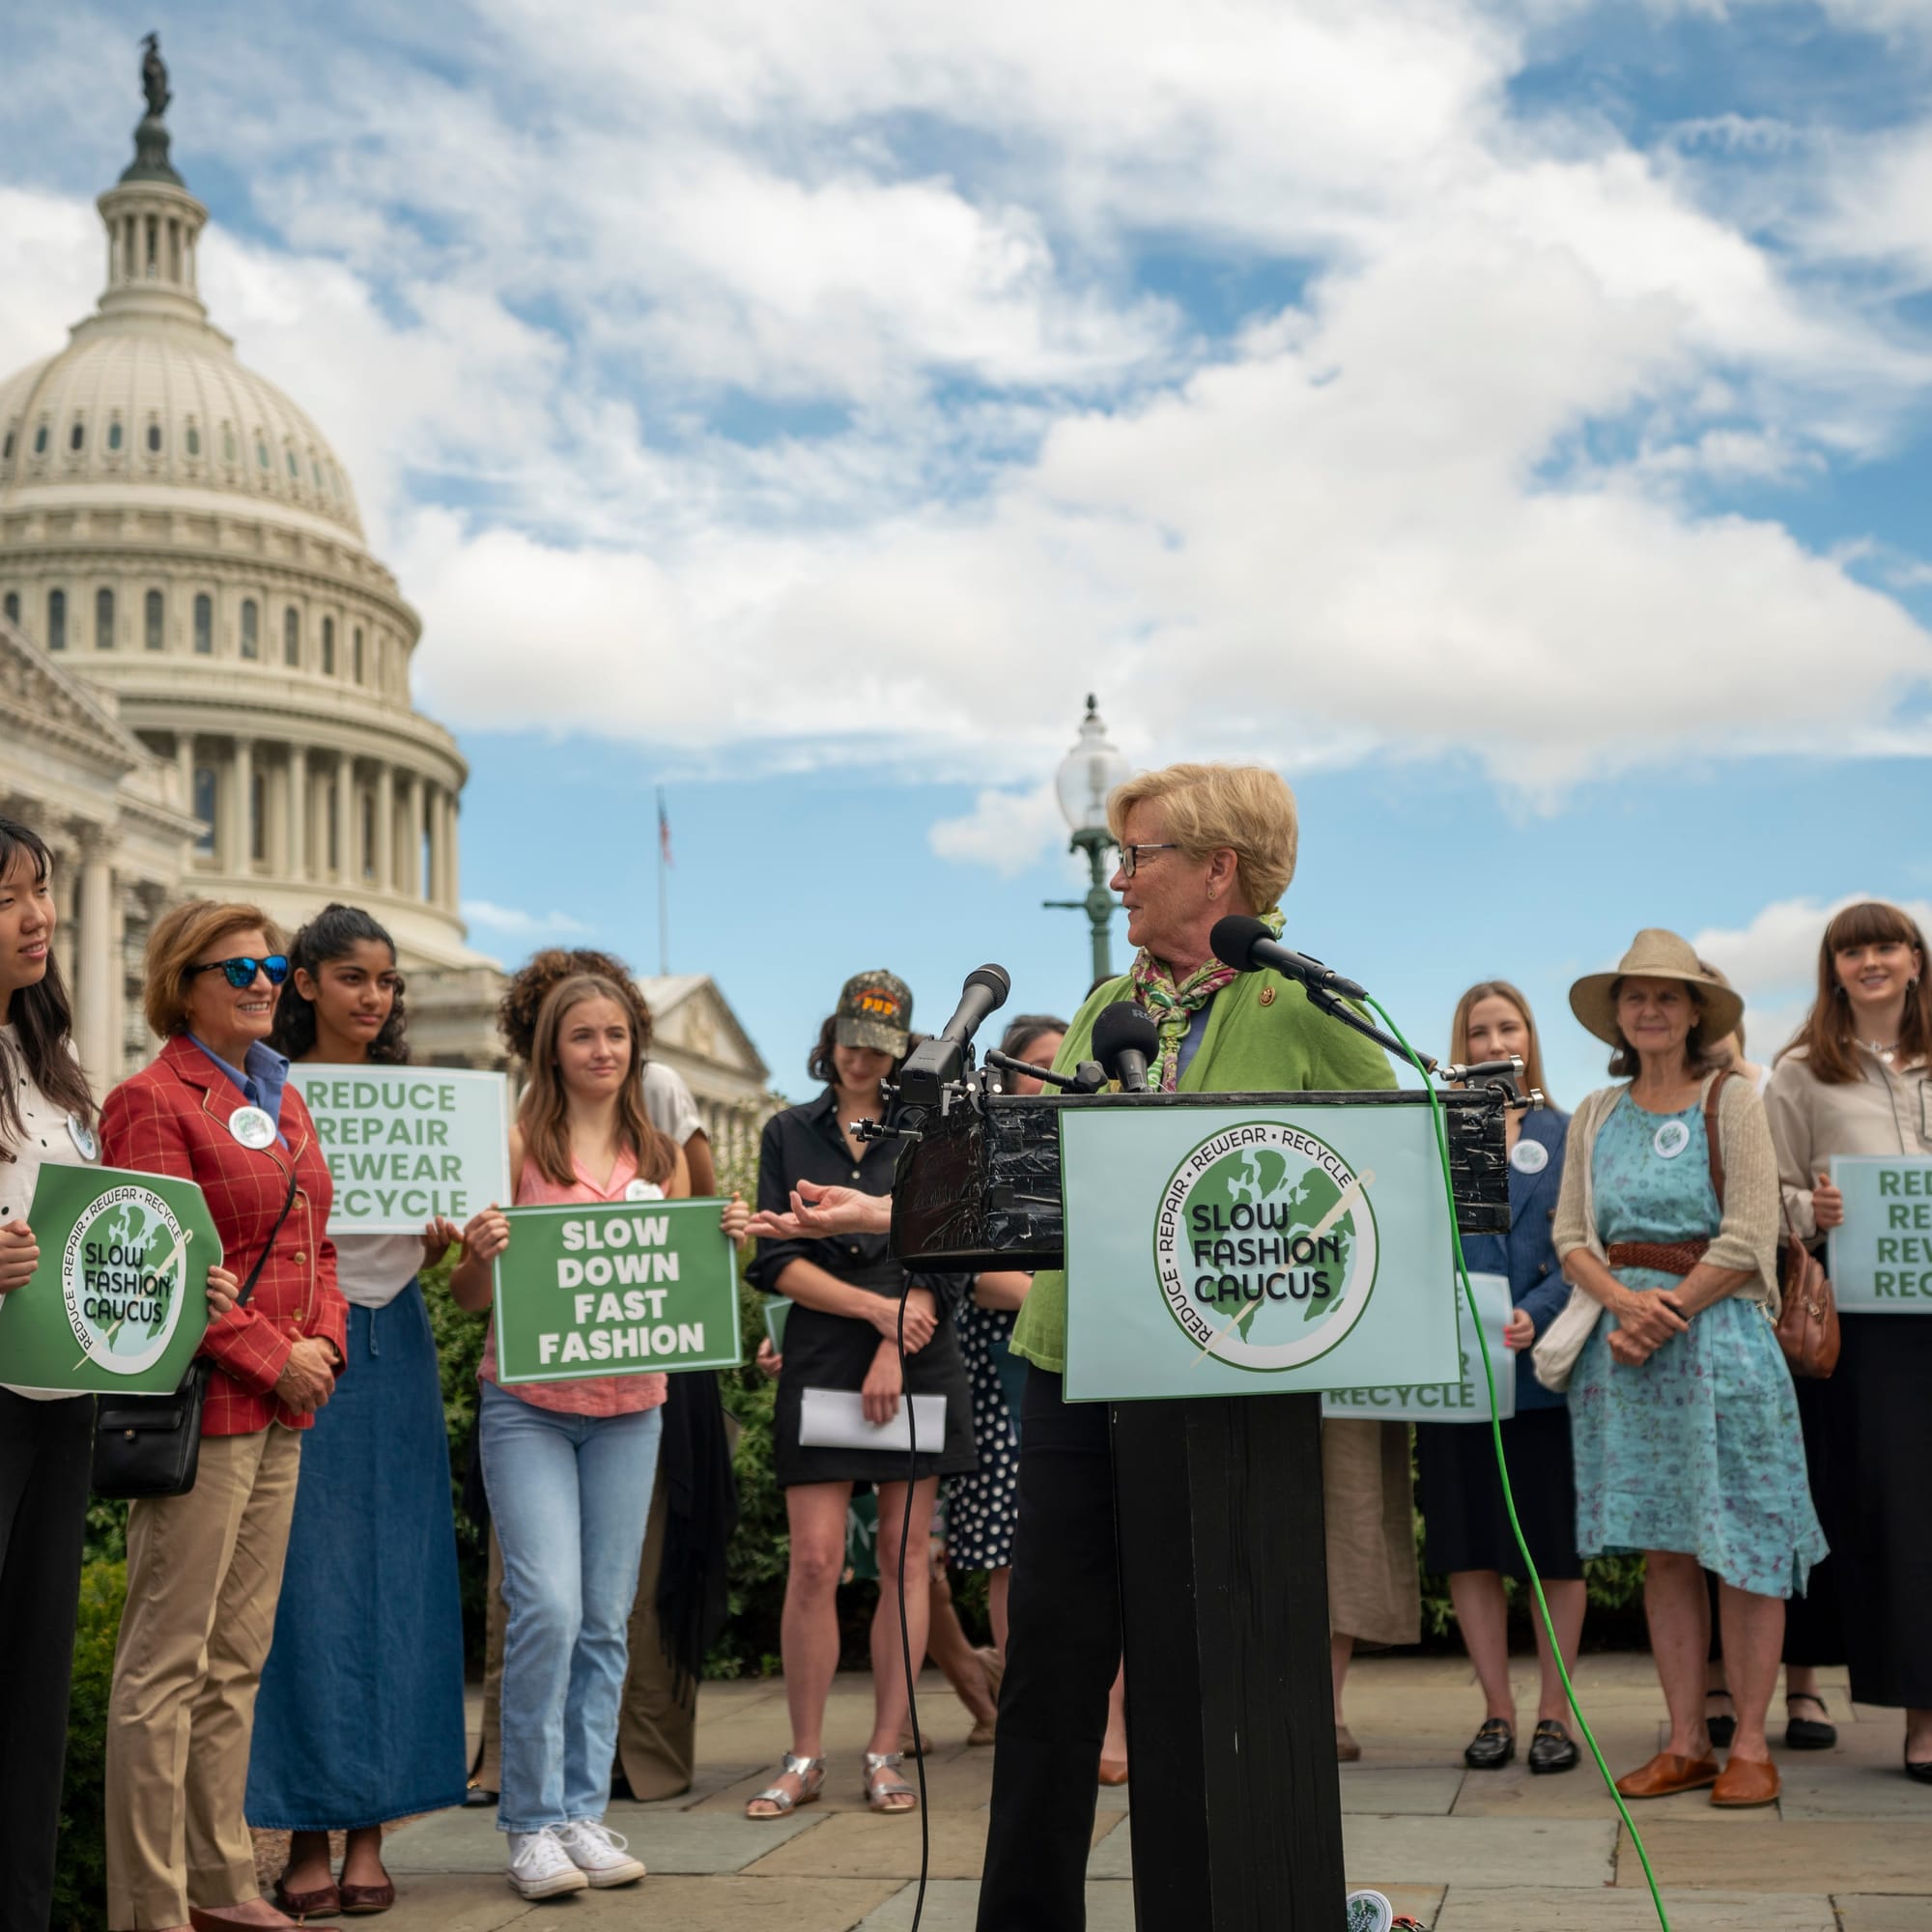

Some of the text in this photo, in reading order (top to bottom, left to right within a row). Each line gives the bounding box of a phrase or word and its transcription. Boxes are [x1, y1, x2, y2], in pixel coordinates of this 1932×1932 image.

[305, 1081, 456, 1111] REDUCE
[315, 1117, 448, 1146] REPAIR
[327, 1152, 463, 1182] EWEAR
[330, 1189, 468, 1218] ECYCLE
[1192, 1203, 1289, 1233] SLOW
[561, 1216, 669, 1251] SLOW
[1159, 1127, 1352, 1344] REDUCE REPAIR REWEAR RECYCLE
[85, 1242, 144, 1267] SLOW
[1194, 1236, 1340, 1267] FASHION
[64, 1188, 182, 1350] REDUCE REPAIR REWEAR RECYCLE
[84, 1270, 171, 1297] FASHION
[556, 1252, 680, 1289] DOWN
[1194, 1270, 1331, 1303] CAUCUS
[83, 1297, 162, 1323] CAUCUS
[574, 1289, 668, 1324] FAST
[538, 1321, 705, 1365] FASHION
